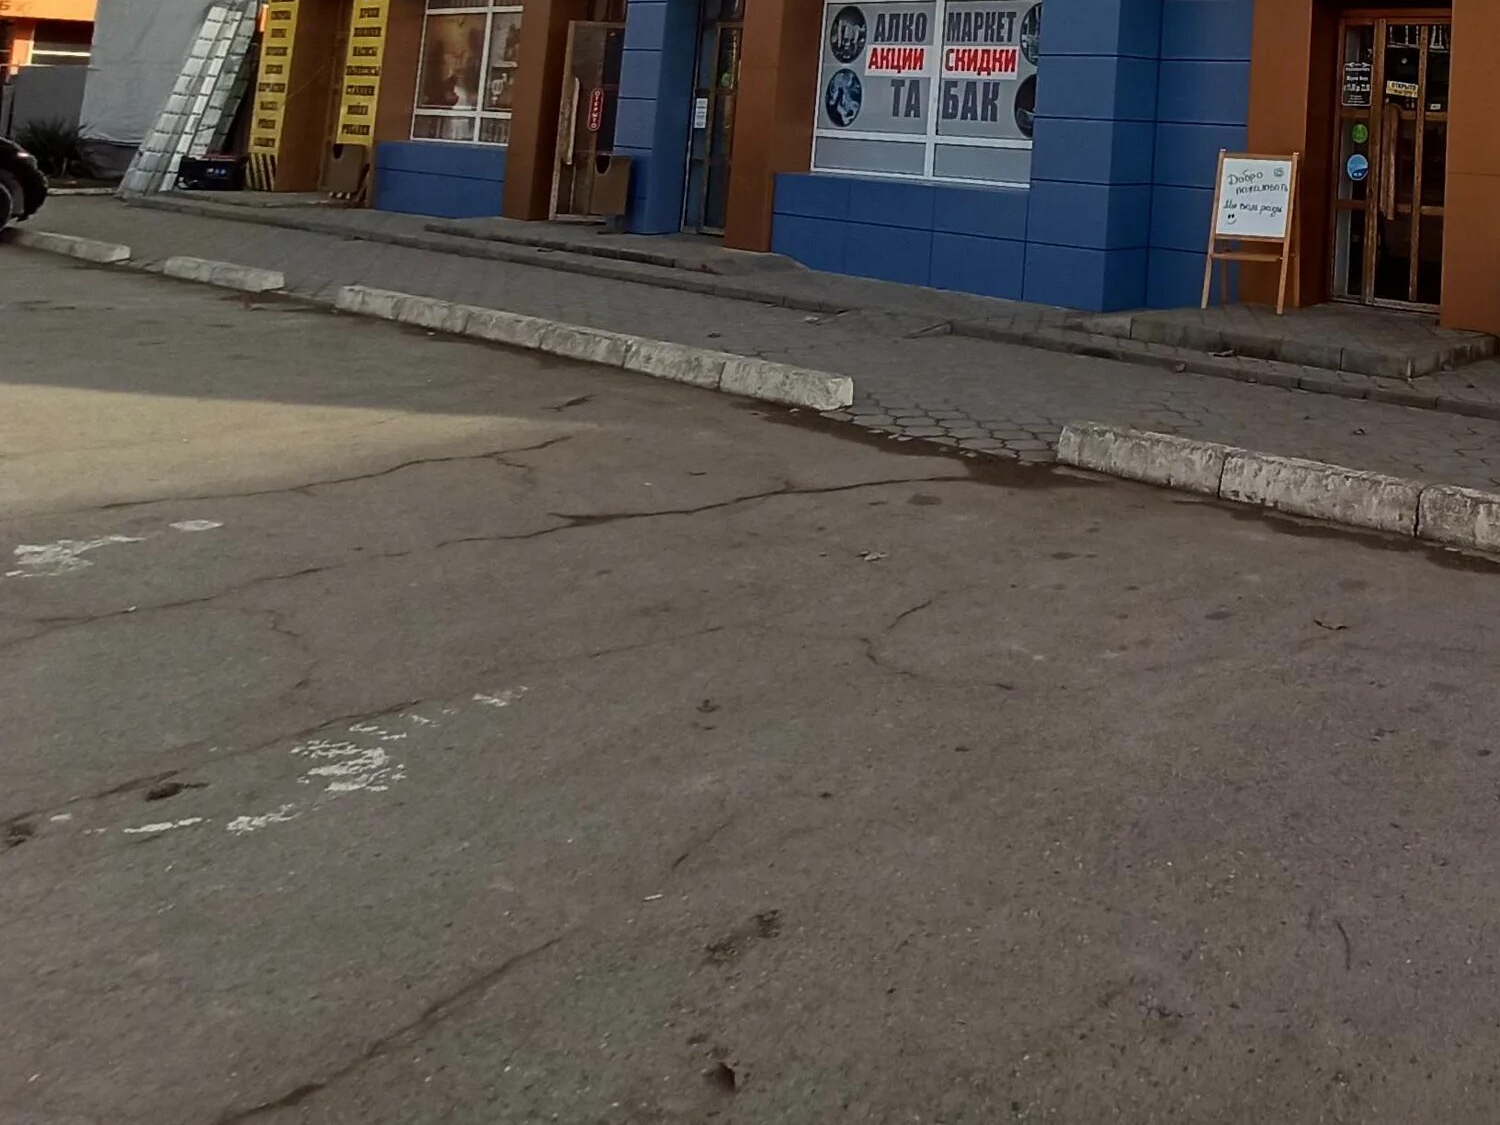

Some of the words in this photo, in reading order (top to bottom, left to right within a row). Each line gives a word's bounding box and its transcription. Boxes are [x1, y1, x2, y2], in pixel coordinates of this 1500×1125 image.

[874, 12, 928, 43] АЛКО
[946, 11, 1017, 43] МАРКЕТ
[868, 47, 925, 74] АКЦИИ
[944, 48, 1017, 76] СКИДКИ
[891, 79, 921, 118] ТА
[941, 80, 1001, 122] БАК
[1228, 169, 1264, 185] Добро
